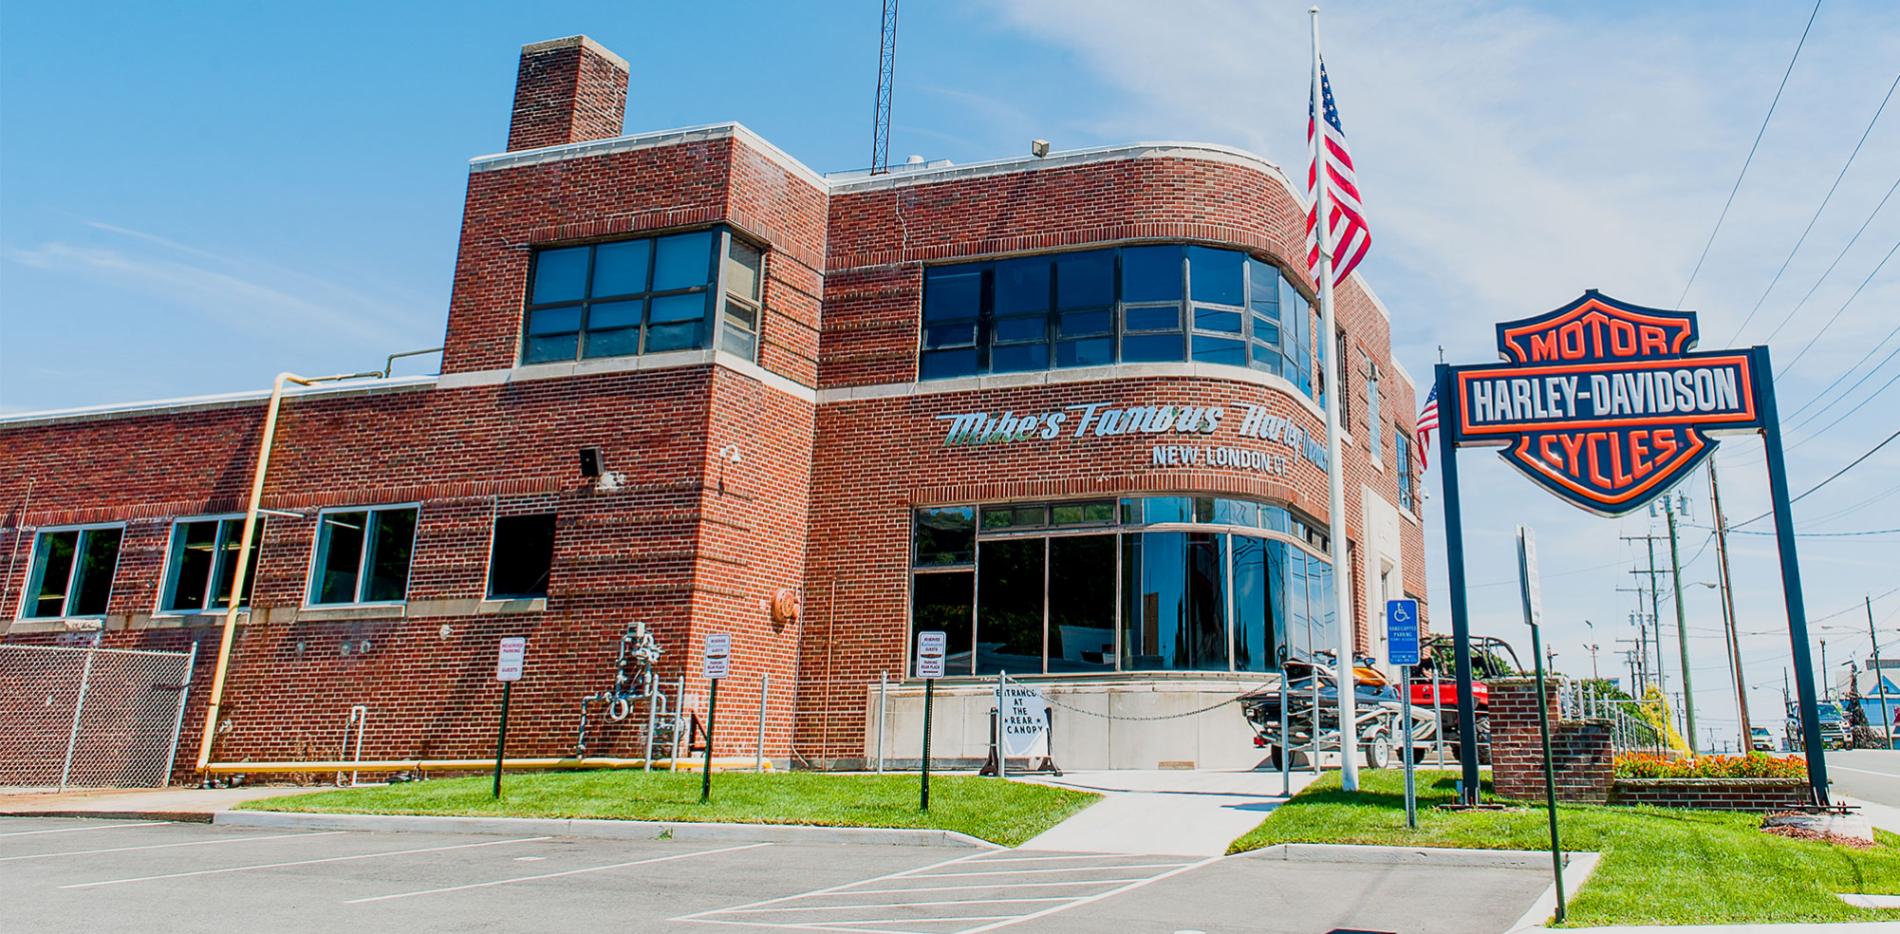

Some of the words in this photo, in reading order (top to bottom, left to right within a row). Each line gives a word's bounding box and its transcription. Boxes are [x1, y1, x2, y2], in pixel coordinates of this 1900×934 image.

[1530, 311, 1668, 362] MOTOR
[1472, 367, 1739, 422] HARLEY-DAVIDSON
[935, 410, 1066, 447] Mike's
[1066, 401, 1224, 438] Famous
[1152, 446, 1199, 466] NEW
[1206, 447, 1271, 473] LONDON
[1539, 429, 1678, 490] CYCLES
[1012, 707, 1028, 716] THE
[1013, 698, 1023, 706] AT
[1006, 725, 1043, 735] CANOPY
[1010, 716, 1033, 725] REAR
